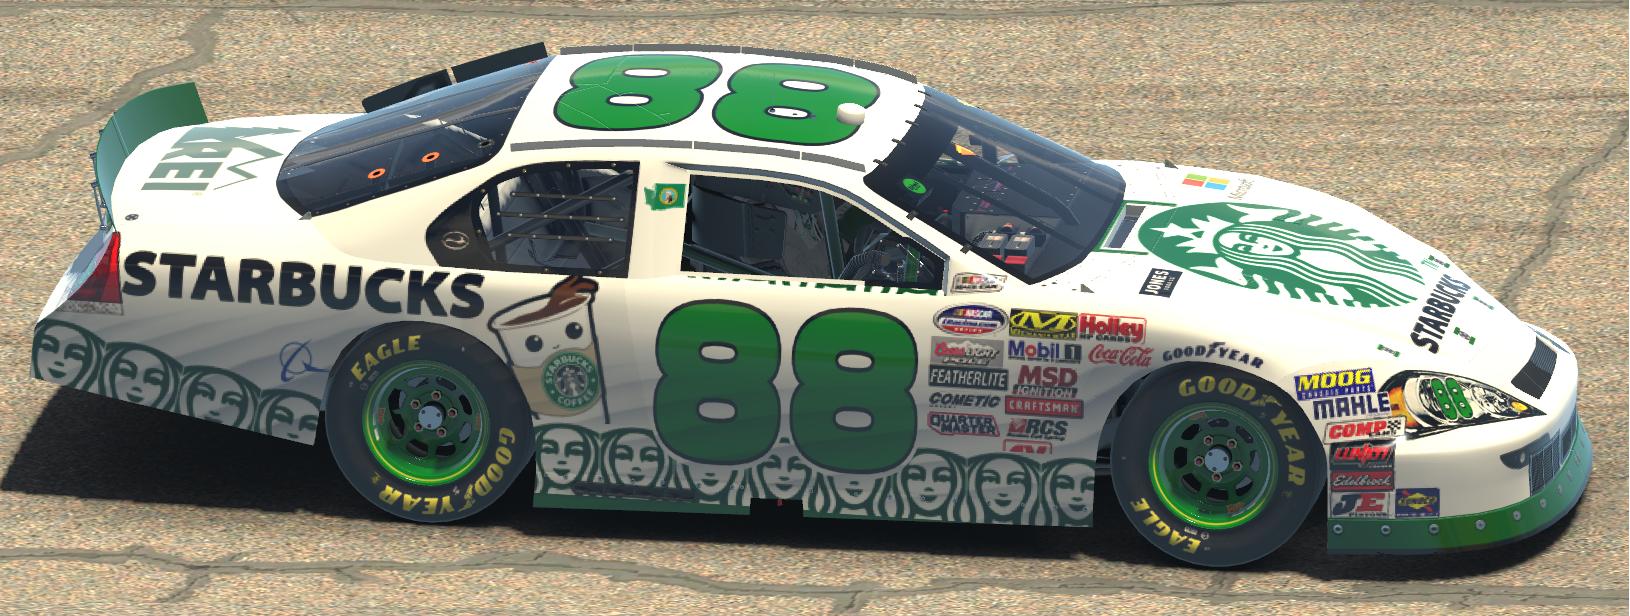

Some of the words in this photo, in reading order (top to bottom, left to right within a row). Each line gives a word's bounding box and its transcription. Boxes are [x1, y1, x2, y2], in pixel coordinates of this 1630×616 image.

[553, 53, 880, 147] 88
[121, 250, 486, 319] STARBUCKS
[1144, 270, 1170, 295] JONES
[1409, 273, 1471, 354] STARBUCKS
[1080, 315, 1144, 343] Holley
[350, 334, 422, 382] EAGLE
[1008, 340, 1060, 360] Mobil
[1162, 342, 1264, 369] GOODYEAR
[545, 355, 593, 384] STARBUCKS
[930, 368, 1007, 388] FEATHERLITE
[1017, 364, 1078, 388] MSD
[1298, 368, 1371, 392] MOOG
[557, 389, 595, 408] COFFEE
[652, 298, 919, 475] 88
[1014, 384, 1078, 398] IGNITION
[928, 391, 1002, 408] COMETIC
[1008, 400, 1079, 414] CRAFTSMAN
[1312, 391, 1391, 420] MAHLE
[931, 414, 993, 426] QUARTER
[940, 421, 997, 434] MASTER
[1025, 418, 1069, 436] RCS
[1178, 374, 1307, 487] GOODYEAR
[1328, 420, 1388, 440] COMP
[377, 426, 517, 515] GOODYEAR
[1332, 474, 1392, 487] Edelbrock
[1332, 492, 1386, 516] JE
[1130, 496, 1202, 554] EAGLE
